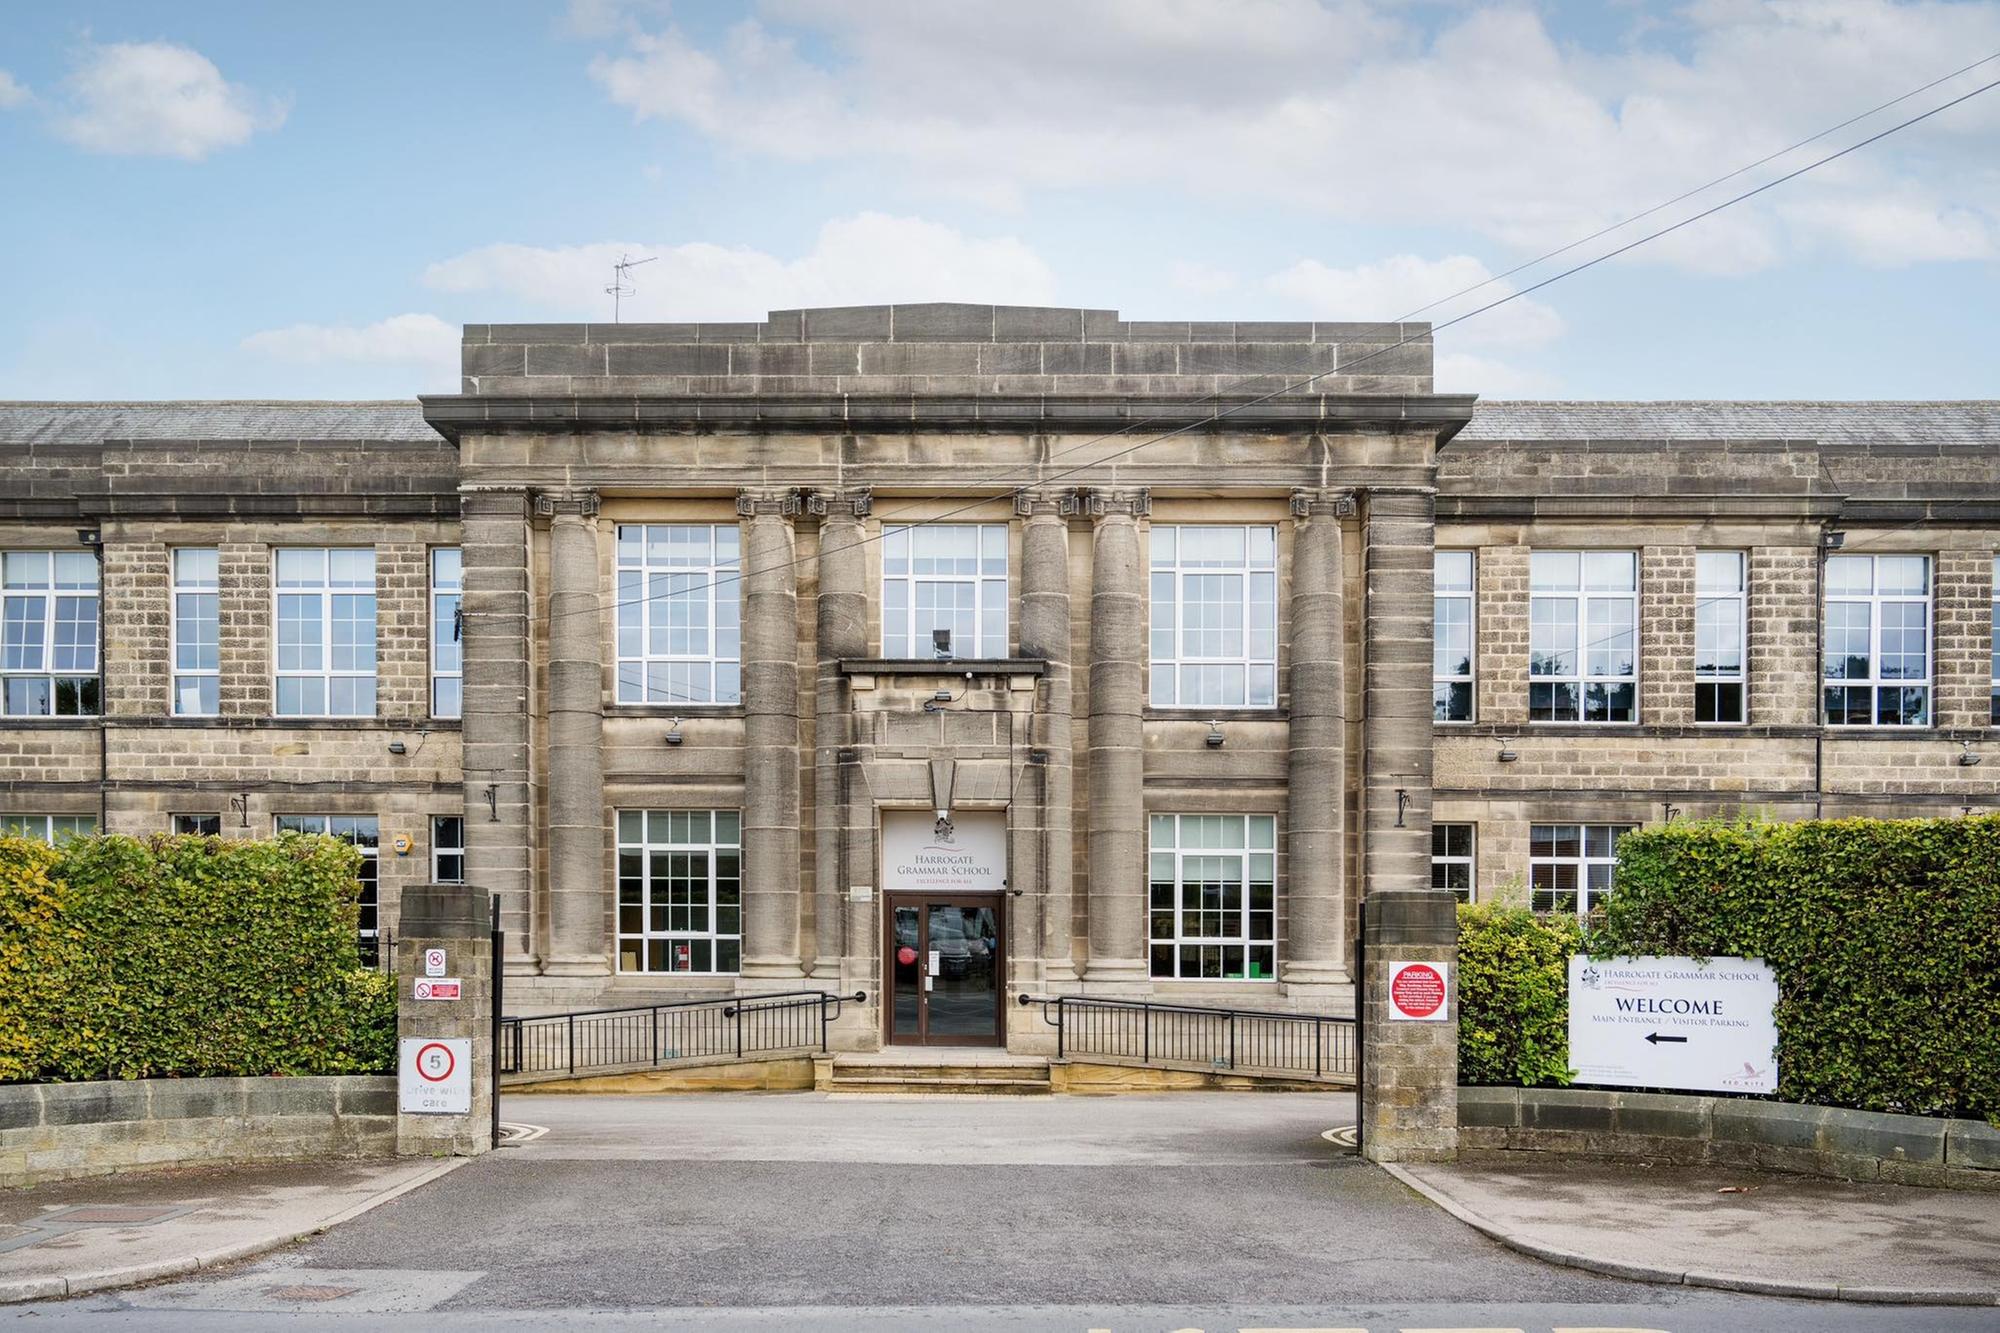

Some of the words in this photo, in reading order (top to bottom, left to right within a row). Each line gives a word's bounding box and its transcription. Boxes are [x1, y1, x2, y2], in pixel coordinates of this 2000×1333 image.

[915, 855, 974, 864] HARROGATE
[897, 866, 948, 875] GRAMMAR
[951, 866, 992, 875] SCHOOL
[1604, 969, 1661, 979] HARROGATE
[1664, 970, 1716, 980] GRAMMAR
[1719, 971, 1760, 981] SCHOOL
[1615, 998, 1724, 1015] WELCOME
[1593, 1015, 1615, 1023] MAIN
[1618, 1016, 1662, 1024] ENTRANCE
[1672, 1017, 1709, 1026] VISITOR
[1710, 1018, 1750, 1027] PARKING
[430, 1055, 441, 1069] 5
[422, 1099, 448, 1107] care
